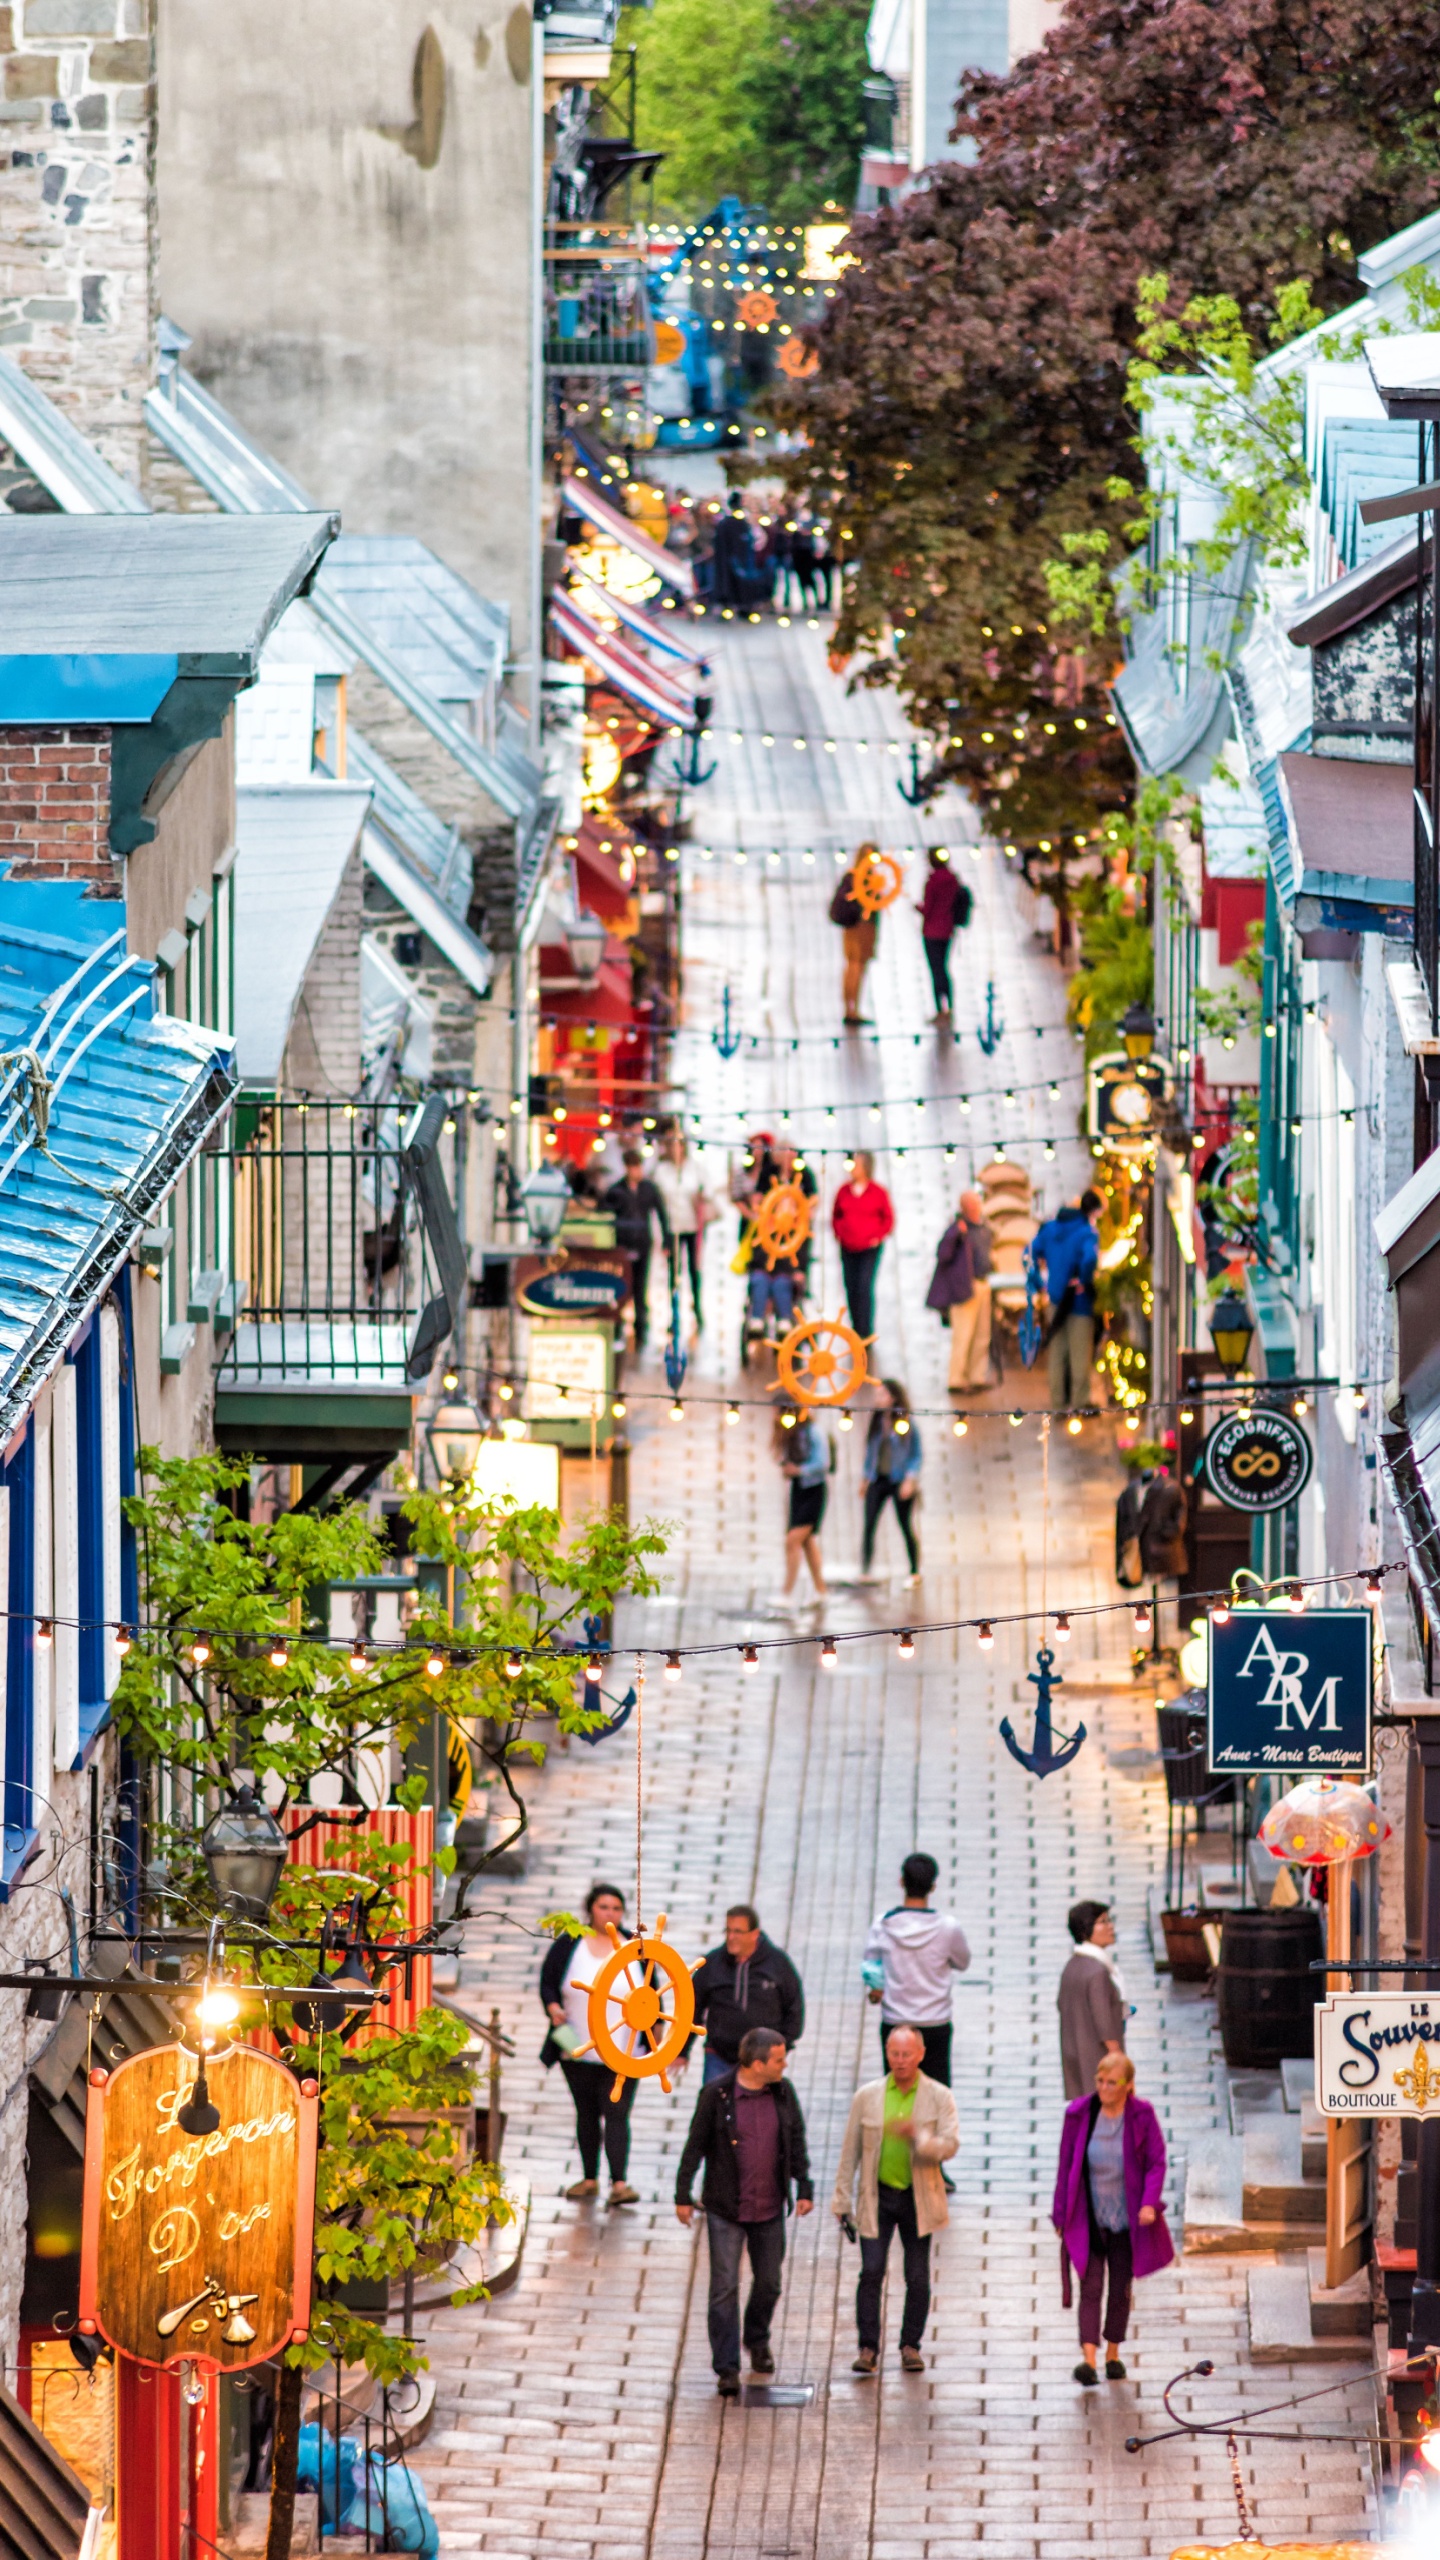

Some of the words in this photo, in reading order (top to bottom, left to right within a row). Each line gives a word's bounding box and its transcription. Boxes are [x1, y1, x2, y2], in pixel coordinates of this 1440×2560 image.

[1217, 1418, 1297, 1456] ECOGRIFFE
[1307, 1744, 1363, 1768] Boutique
[1410, 2003, 1430, 2017] LE
[1328, 2093, 1398, 2108] BOUTIQUE
[106, 2109, 297, 2220] Forgeron
